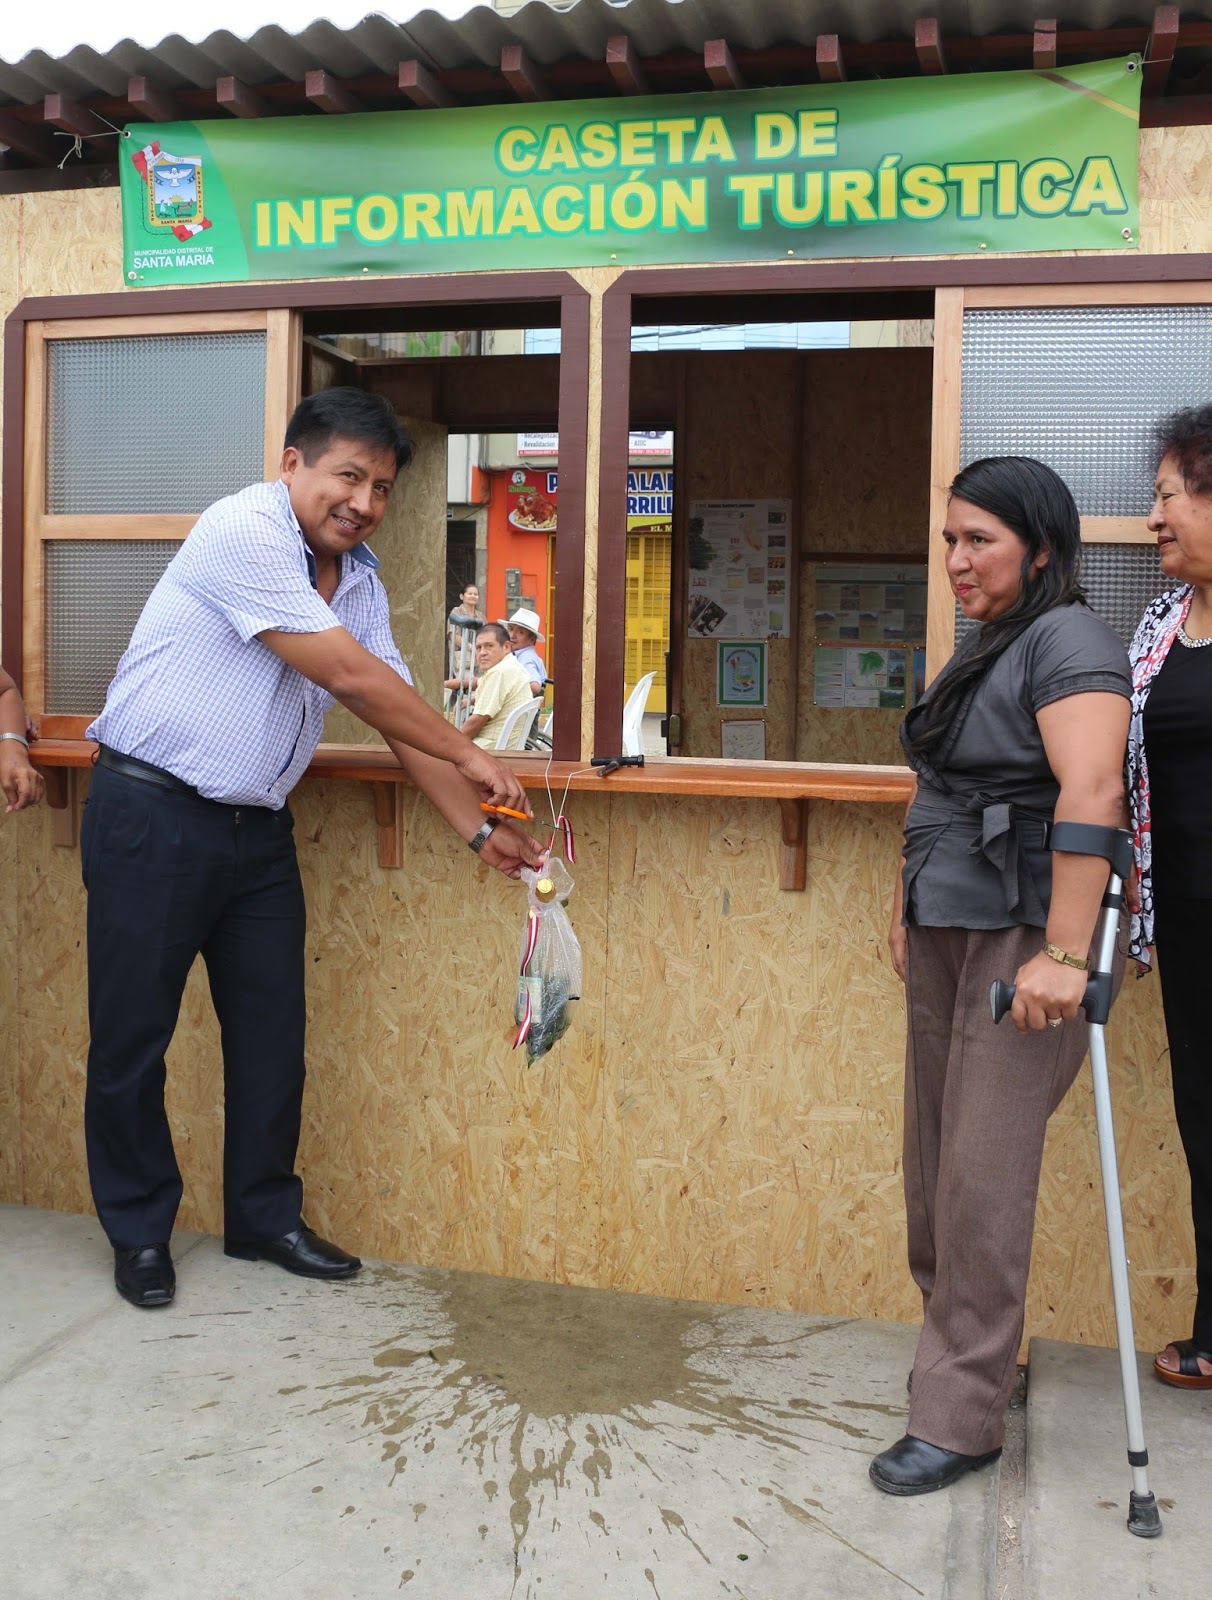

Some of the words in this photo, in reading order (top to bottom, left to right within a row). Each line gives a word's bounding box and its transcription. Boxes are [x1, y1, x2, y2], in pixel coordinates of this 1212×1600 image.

[499, 116, 736, 173] CASETA
[755, 110, 839, 160] DE
[255, 170, 708, 247] INFORMACIÓN
[730, 155, 1128, 226] TURÍSTICA
[133, 248, 176, 256] MUNICIPALIDAD
[133, 256, 174, 269] SANTA
[175, 253, 215, 267] MARIA
